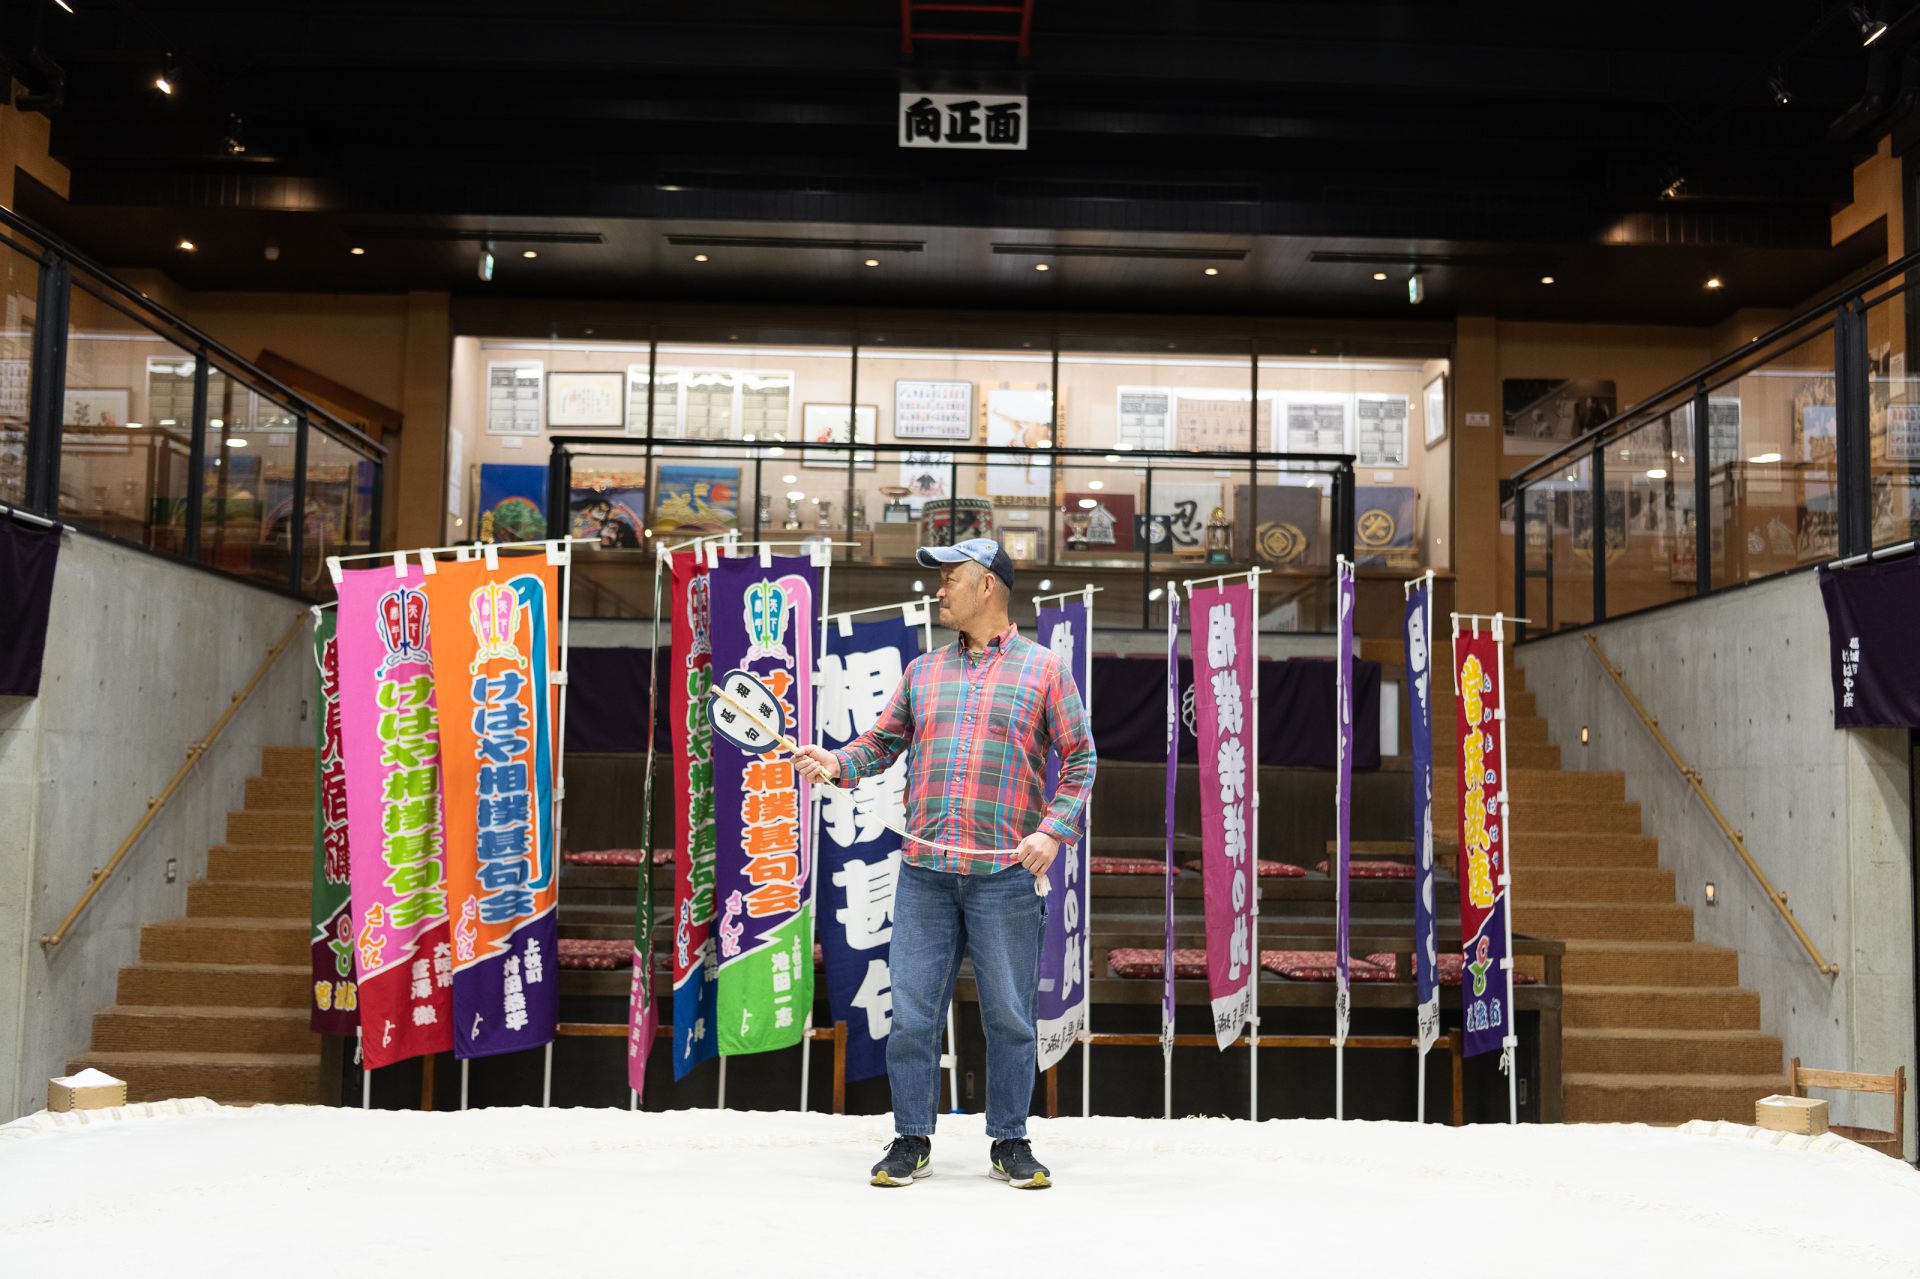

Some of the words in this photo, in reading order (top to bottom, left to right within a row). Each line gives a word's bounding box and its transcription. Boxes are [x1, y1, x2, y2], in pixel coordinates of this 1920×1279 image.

[904, 97, 1022, 146] 向正面
[376, 674, 449, 928] けはや相撲甚句会
[470, 669, 537, 924] けはや相撲甚句会
[740, 667, 801, 918] け相撲甚句会
